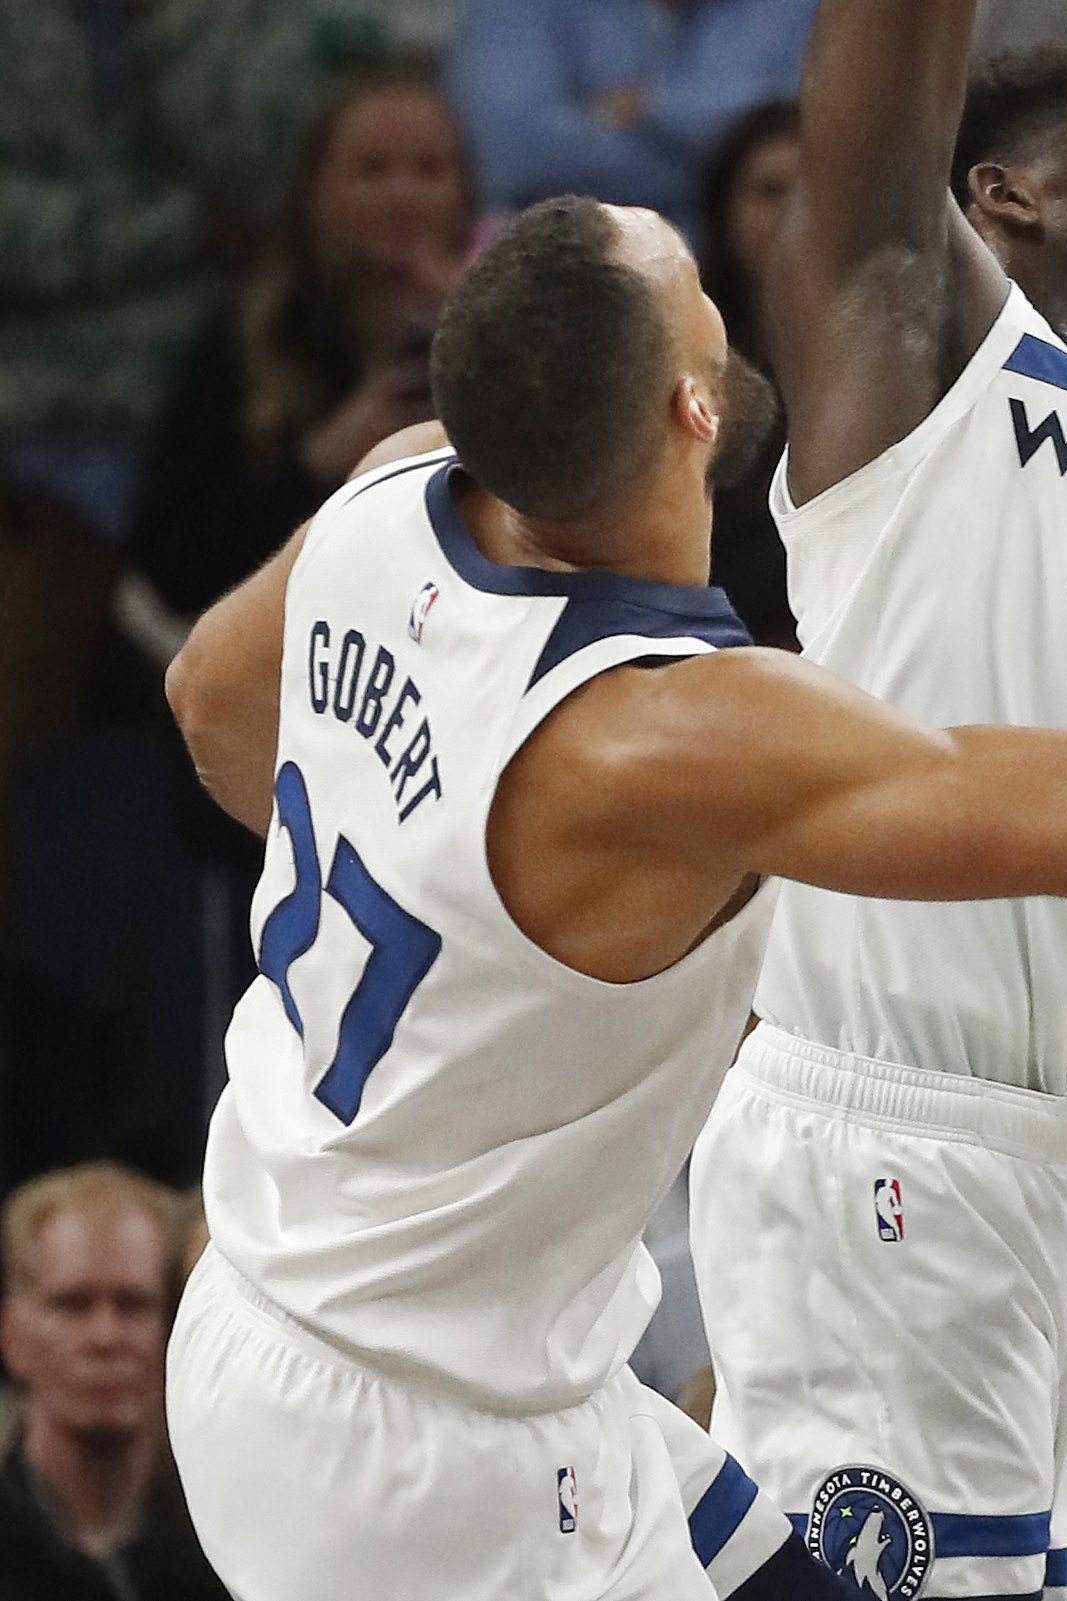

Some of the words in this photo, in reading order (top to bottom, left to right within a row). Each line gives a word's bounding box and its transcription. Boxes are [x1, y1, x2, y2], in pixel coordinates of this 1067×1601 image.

[309, 621, 442, 824] GOBERT
[259, 760, 442, 1127] 27
[860, 1471, 927, 1598] TIMBERWOLVES
